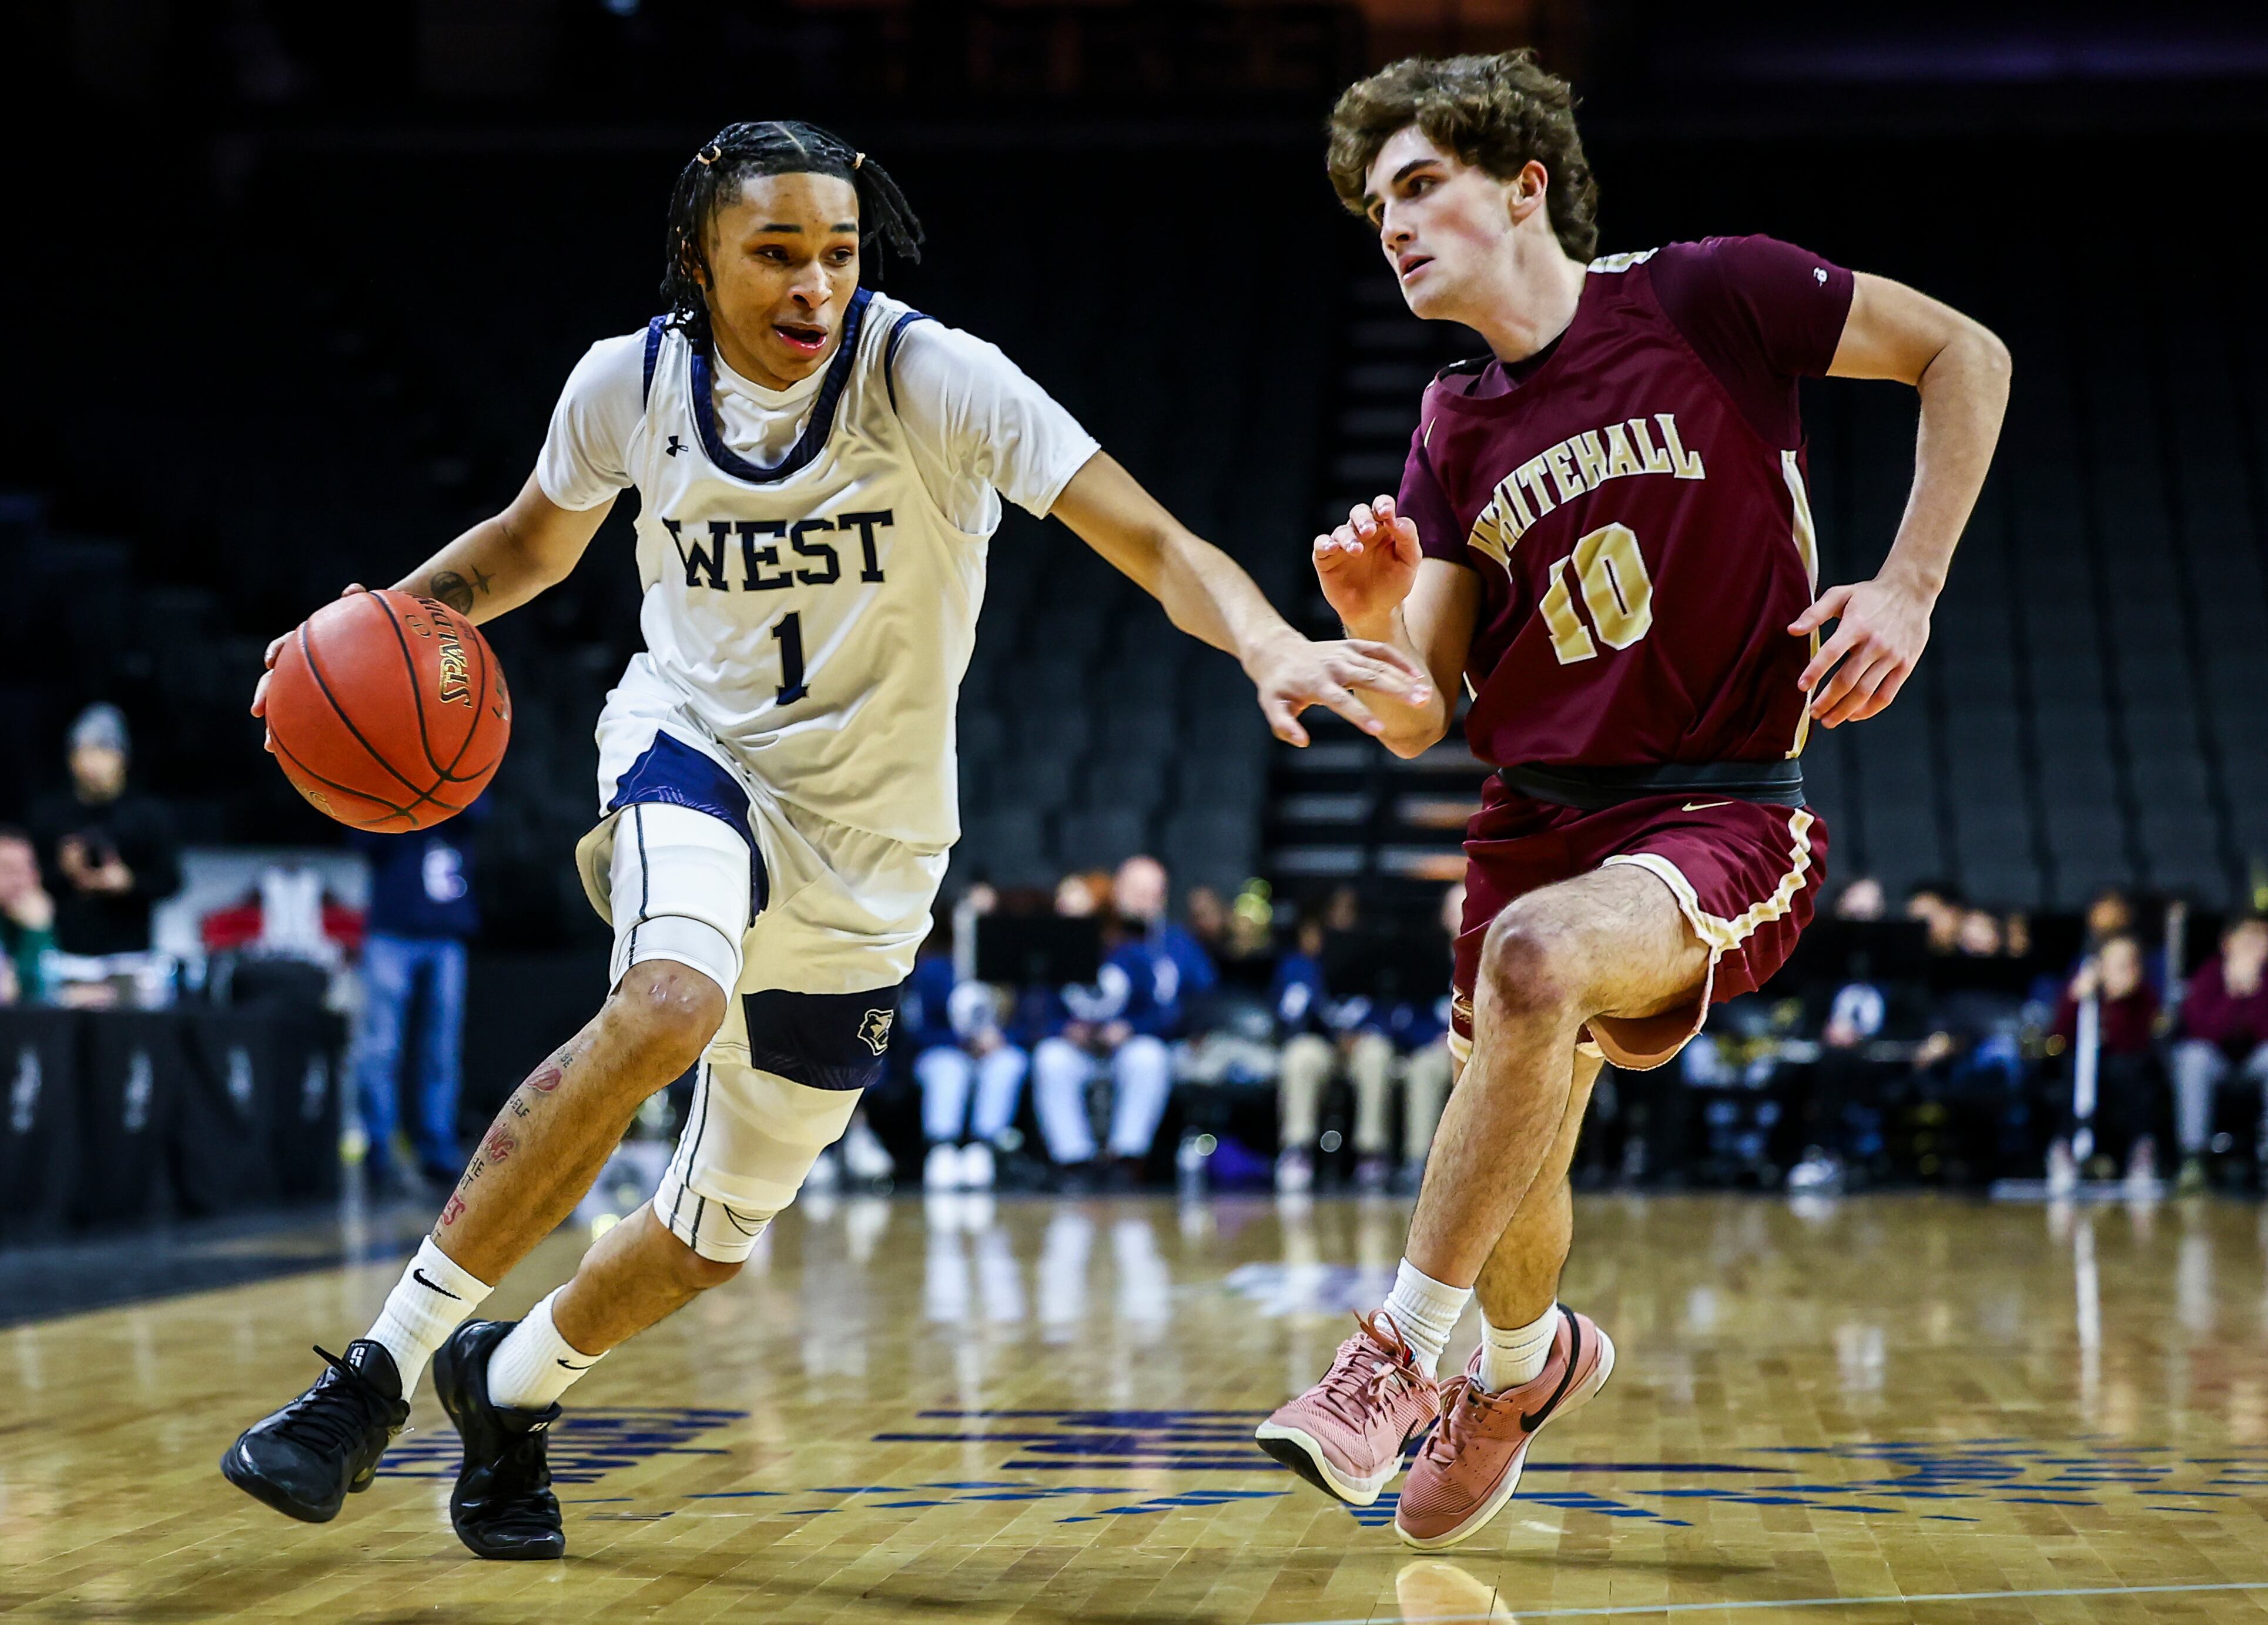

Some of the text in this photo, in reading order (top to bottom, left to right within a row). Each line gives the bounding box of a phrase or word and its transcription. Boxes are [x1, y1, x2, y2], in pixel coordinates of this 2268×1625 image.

[662, 508, 894, 592] WEST
[1539, 521, 1654, 665] 10
[770, 610, 810, 706] 1
